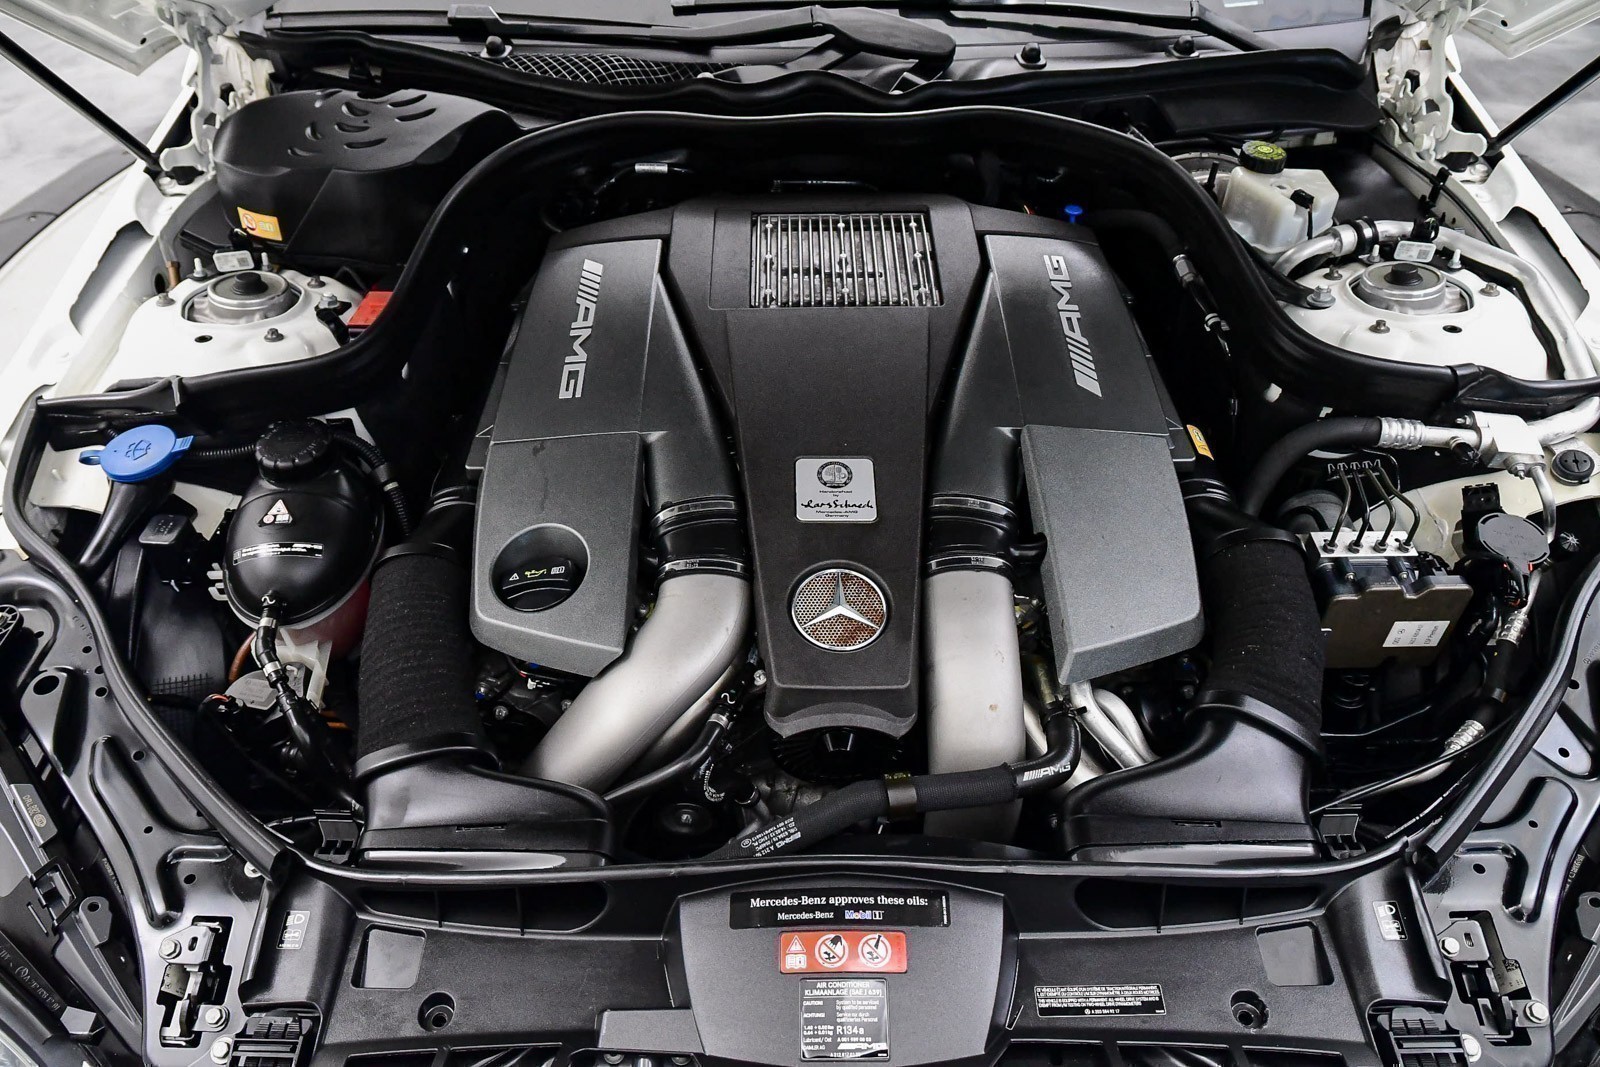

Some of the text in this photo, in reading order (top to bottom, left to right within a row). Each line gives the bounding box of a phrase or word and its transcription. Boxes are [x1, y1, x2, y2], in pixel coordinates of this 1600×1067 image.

[559, 297, 596, 399] AMG
[1039, 762, 1070, 778] AMG
[750, 896, 928, 908] Mercedes-Benz approves these oils:
[777, 911, 834, 920] Mercedes-Benz
[844, 910, 872, 920] Mobil
